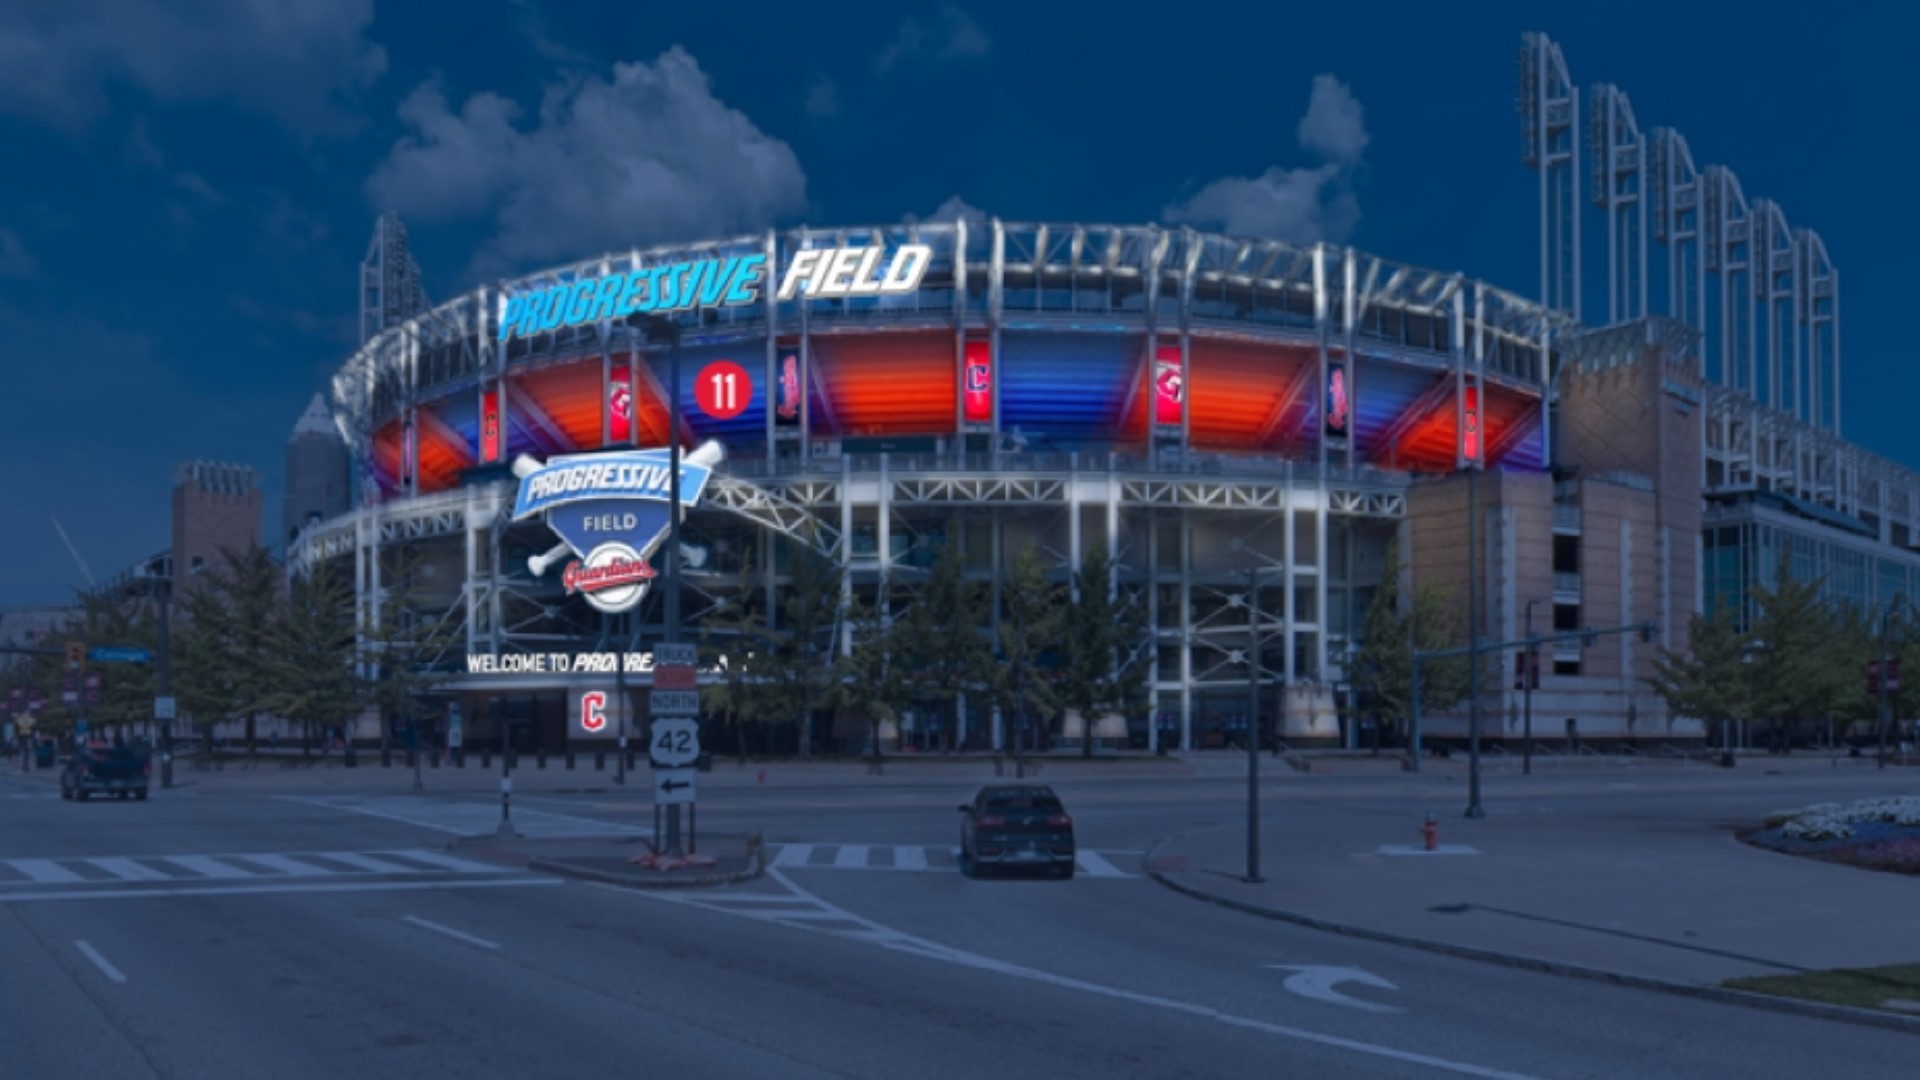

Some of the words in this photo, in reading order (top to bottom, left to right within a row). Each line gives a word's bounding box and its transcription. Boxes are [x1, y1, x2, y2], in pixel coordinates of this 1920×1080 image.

[499, 254, 766, 341] PROGRESSIVE
[778, 243, 929, 300] FIELD
[583, 513, 638, 532] FIELD
[562, 557, 657, 594] Guardians
[468, 653, 546, 673] WELCOME
[550, 653, 568, 673] TO
[657, 651, 694, 661] TRUCK
[582, 690, 605, 732] C
[653, 695, 698, 711] NORTH
[657, 731, 692, 753] 42
